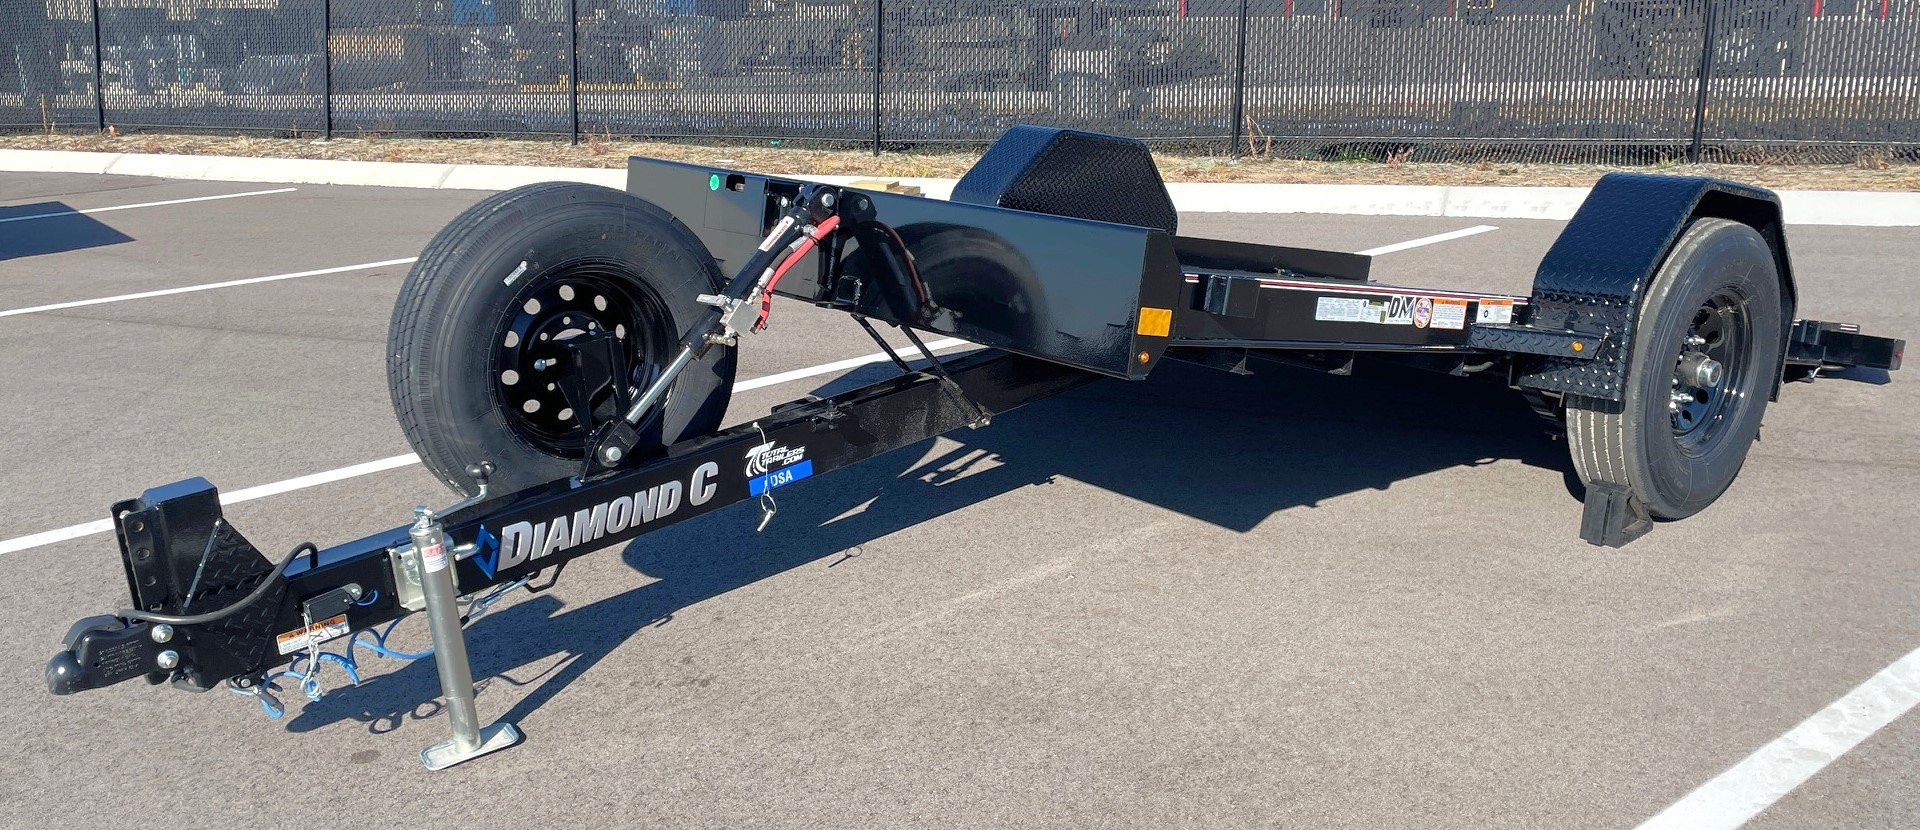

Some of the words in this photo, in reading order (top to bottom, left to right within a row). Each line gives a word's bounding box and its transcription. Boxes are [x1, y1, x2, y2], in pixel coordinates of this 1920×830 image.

[762, 445, 789, 460] TOTAL
[762, 446, 806, 466] TRAILERS
[497, 479, 683, 572] DIAMOND
[690, 461, 719, 507] C
